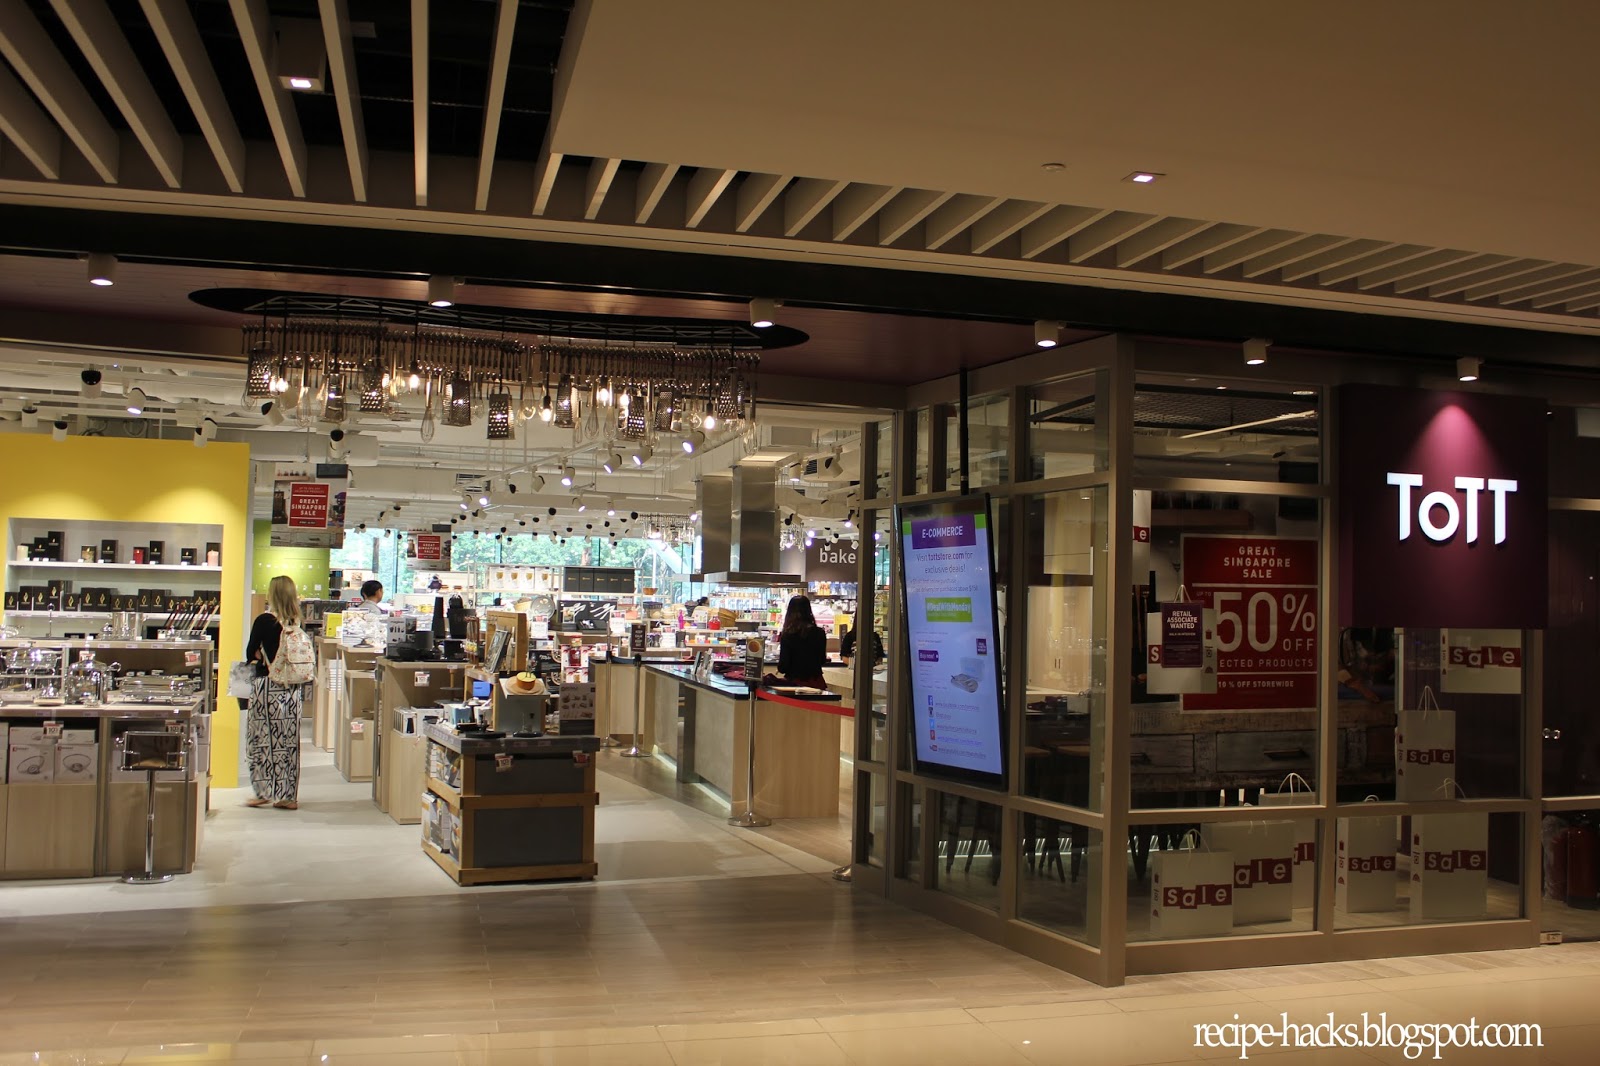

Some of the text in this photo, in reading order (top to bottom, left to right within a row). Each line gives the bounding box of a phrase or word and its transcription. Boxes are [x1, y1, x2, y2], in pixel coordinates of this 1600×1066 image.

[1386, 472, 1518, 546] ToTT
[921, 525, 964, 539] E-COMMERCE
[819, 548, 856, 564] bake
[916, 553, 928, 562] Visit
[965, 551, 974, 560] for
[1238, 546, 1276, 556] GREAT
[1223, 557, 1291, 568] SINGAPORE
[925, 564, 966, 574] exclusive deals!
[1242, 568, 1273, 579] SALE
[1213, 591, 1316, 653] 50%
[1282, 638, 1315, 652] OFF
[1219, 658, 1314, 668] ECTED PRODUCTS
[1236, 680, 1251, 688] OFF
[1252, 680, 1294, 688] STOREWIDE
[1235, 861, 1287, 885] ale
